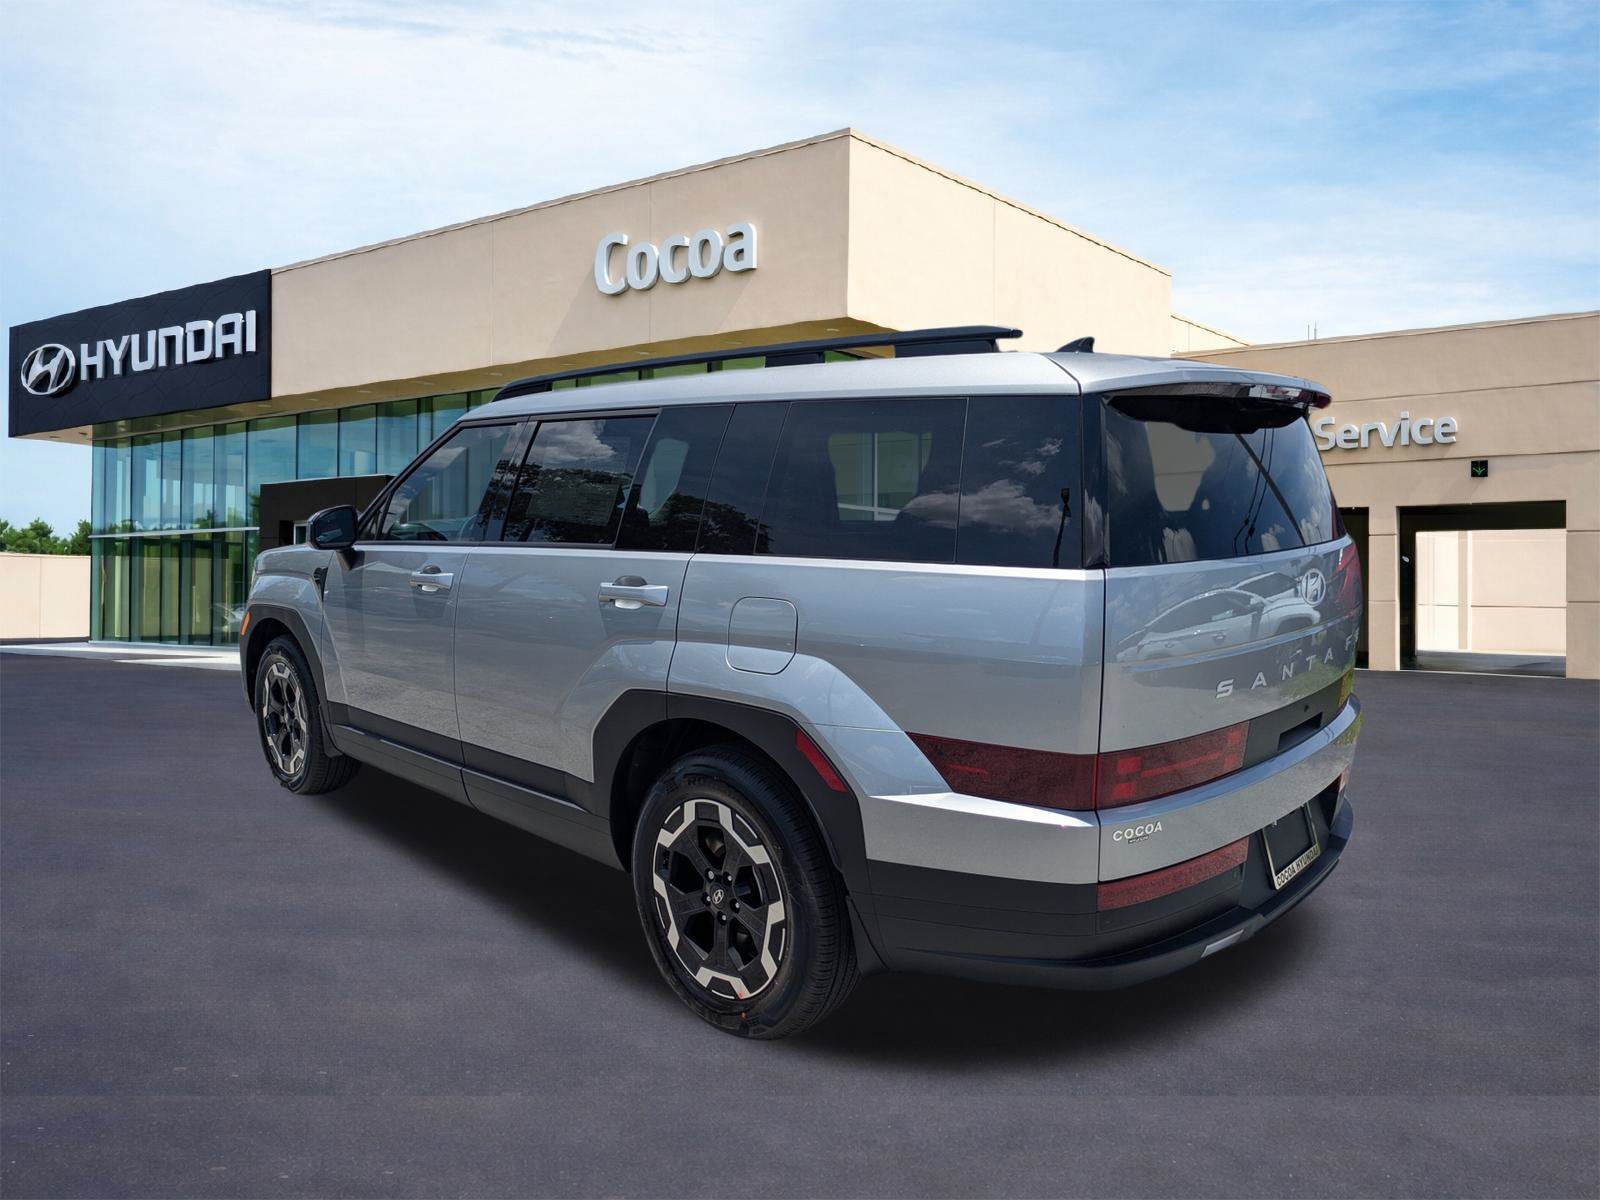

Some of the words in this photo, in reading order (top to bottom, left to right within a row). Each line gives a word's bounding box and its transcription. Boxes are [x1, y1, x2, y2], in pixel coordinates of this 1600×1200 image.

[594, 222, 758, 295] Cocoa
[80, 309, 257, 381] HYUNDAI
[1313, 411, 1458, 450] Service
[1216, 647, 1334, 699] SANTA
[1112, 821, 1162, 842] COCOA
[1276, 864, 1297, 886] COCOA
